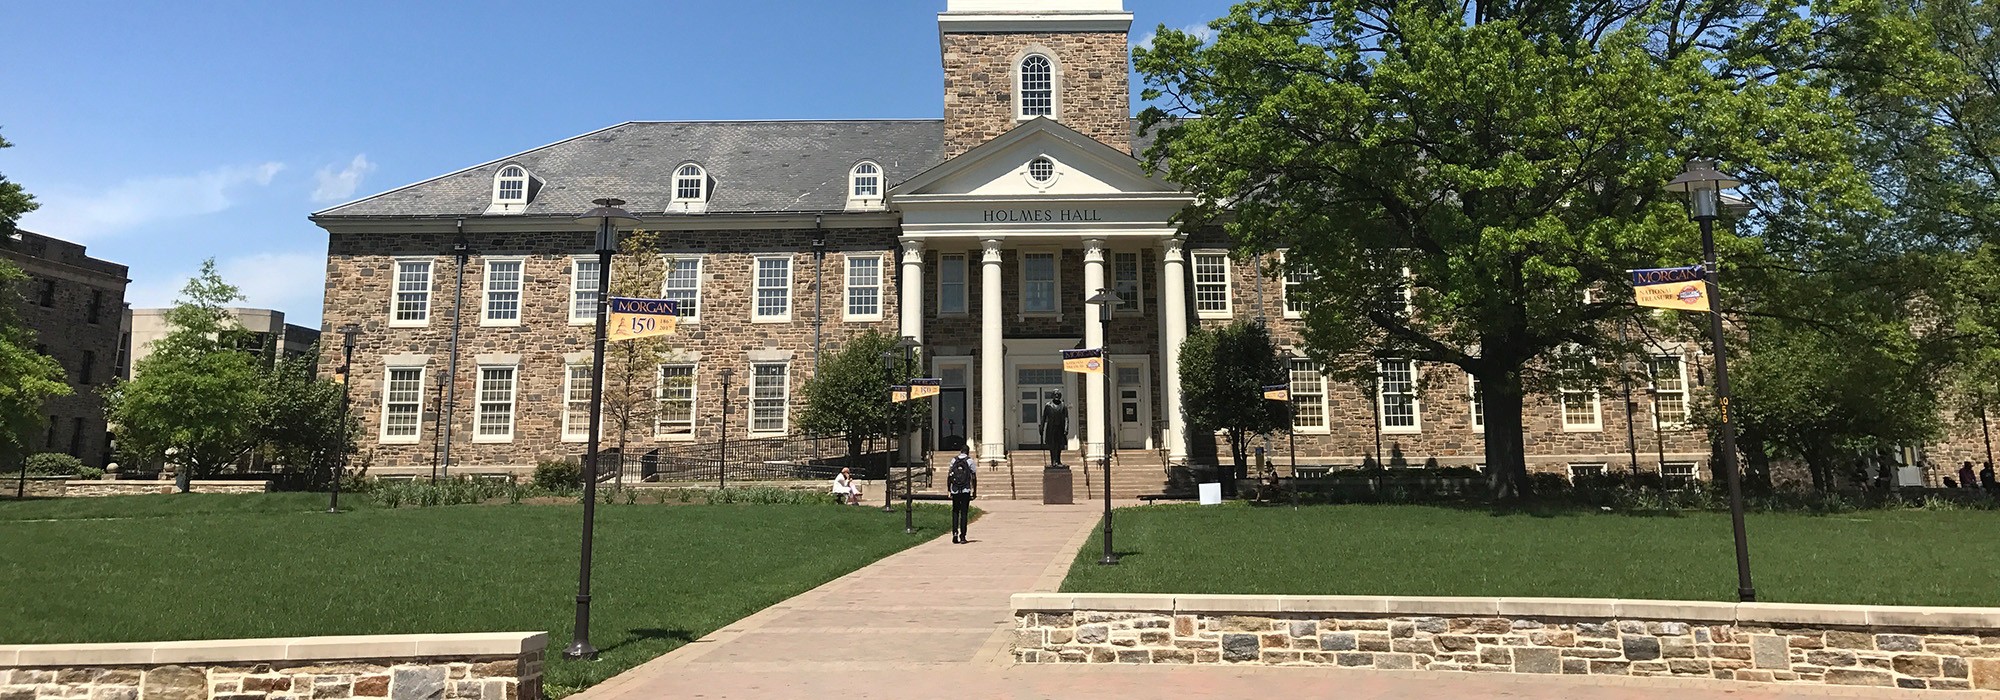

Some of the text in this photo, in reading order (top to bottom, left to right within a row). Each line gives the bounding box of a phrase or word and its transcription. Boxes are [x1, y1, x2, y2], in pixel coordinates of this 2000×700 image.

[983, 209, 1102, 222] HOLMES HALL
[1638, 269, 1697, 284] MORGAN
[618, 301, 674, 313] MORGAN
[632, 316, 655, 334] 150
